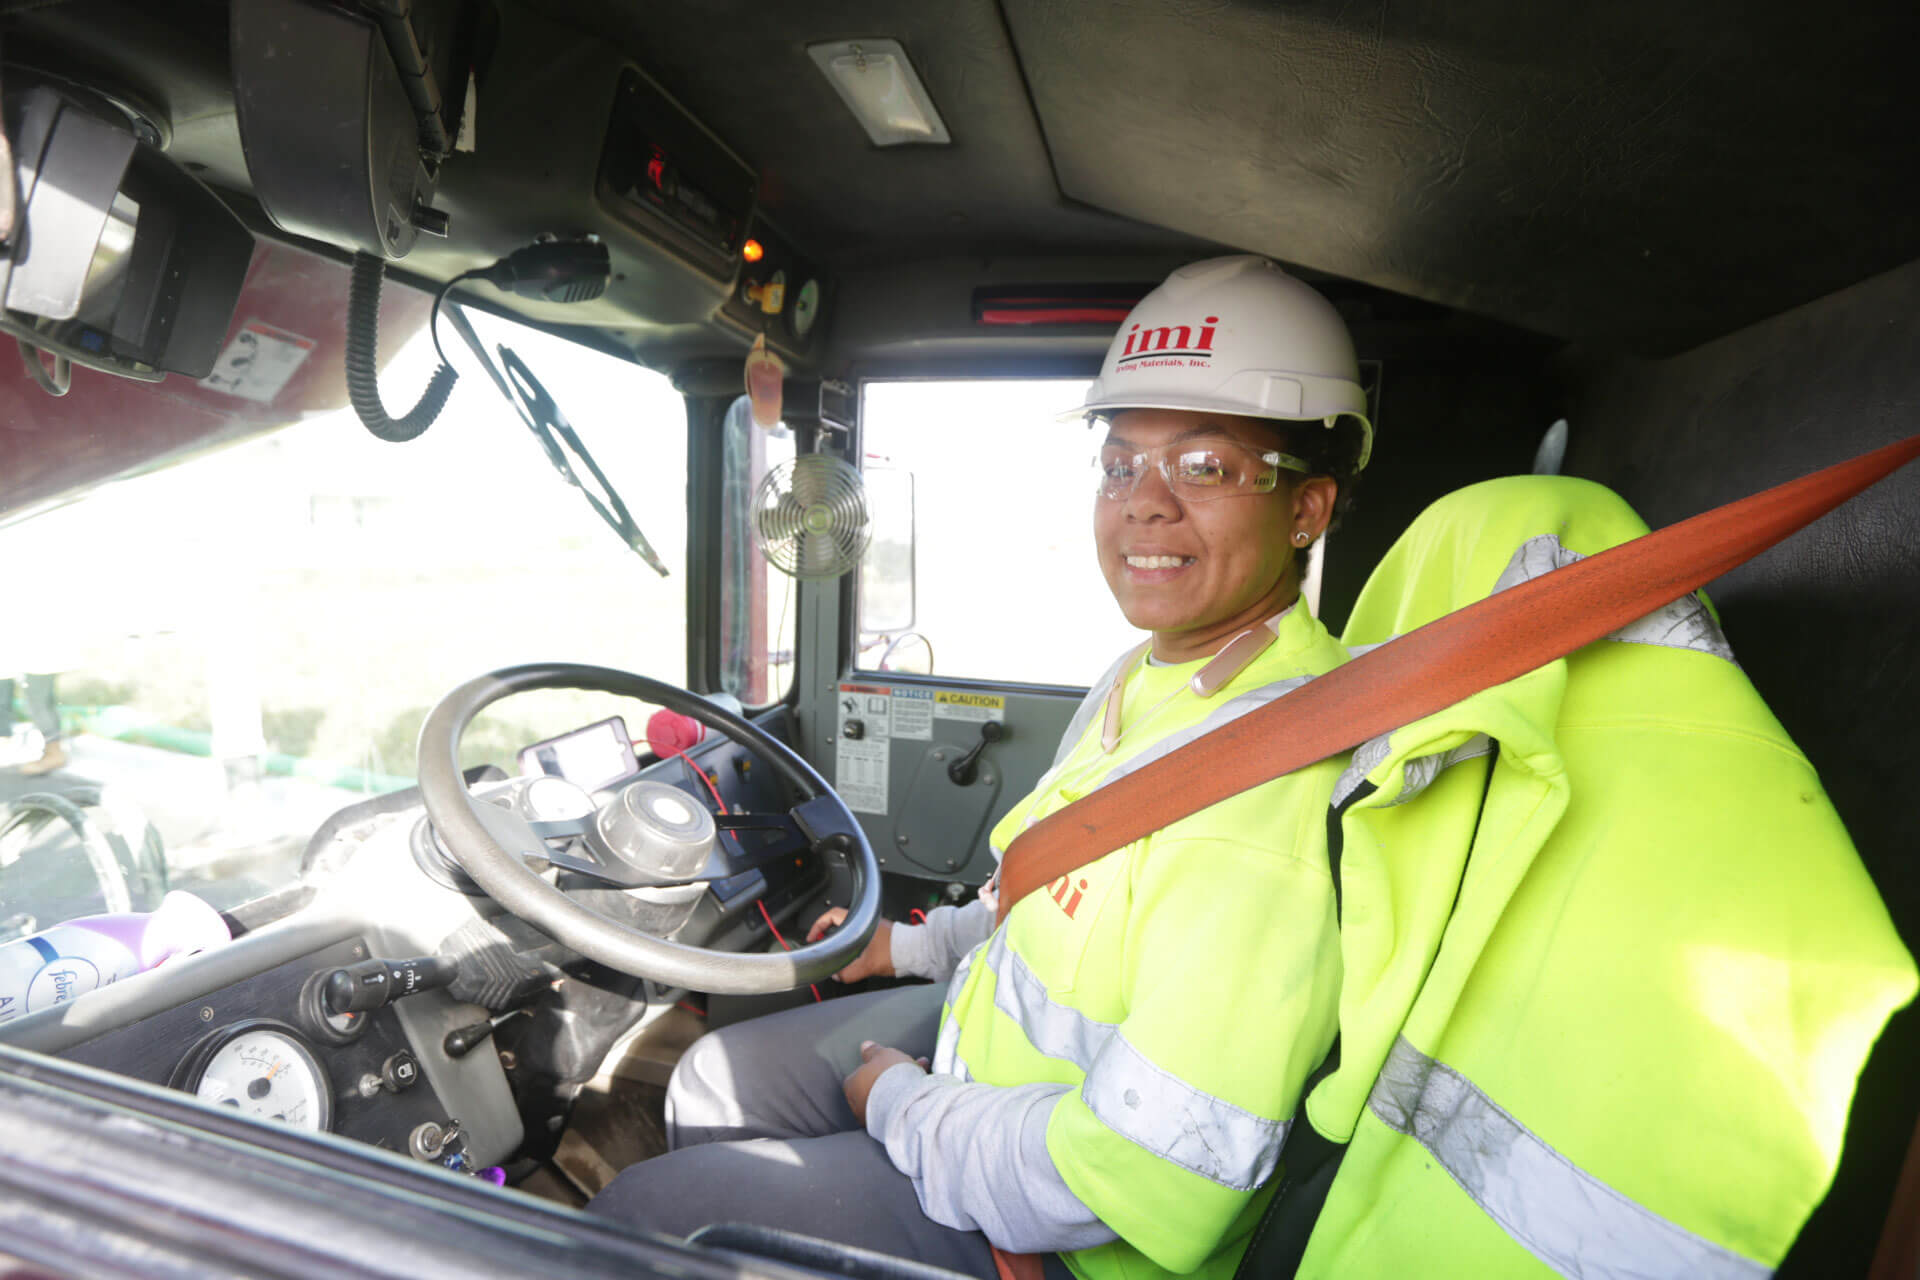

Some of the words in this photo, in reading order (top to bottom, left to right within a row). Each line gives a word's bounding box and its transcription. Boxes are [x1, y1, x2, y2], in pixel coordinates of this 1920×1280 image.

[1121, 316, 1219, 357] imi
[1140, 359, 1185, 368] Materials,
[1189, 359, 1211, 368] Inc.
[950, 694, 1000, 706] CAUTION
[47, 968, 78, 1004] febre
